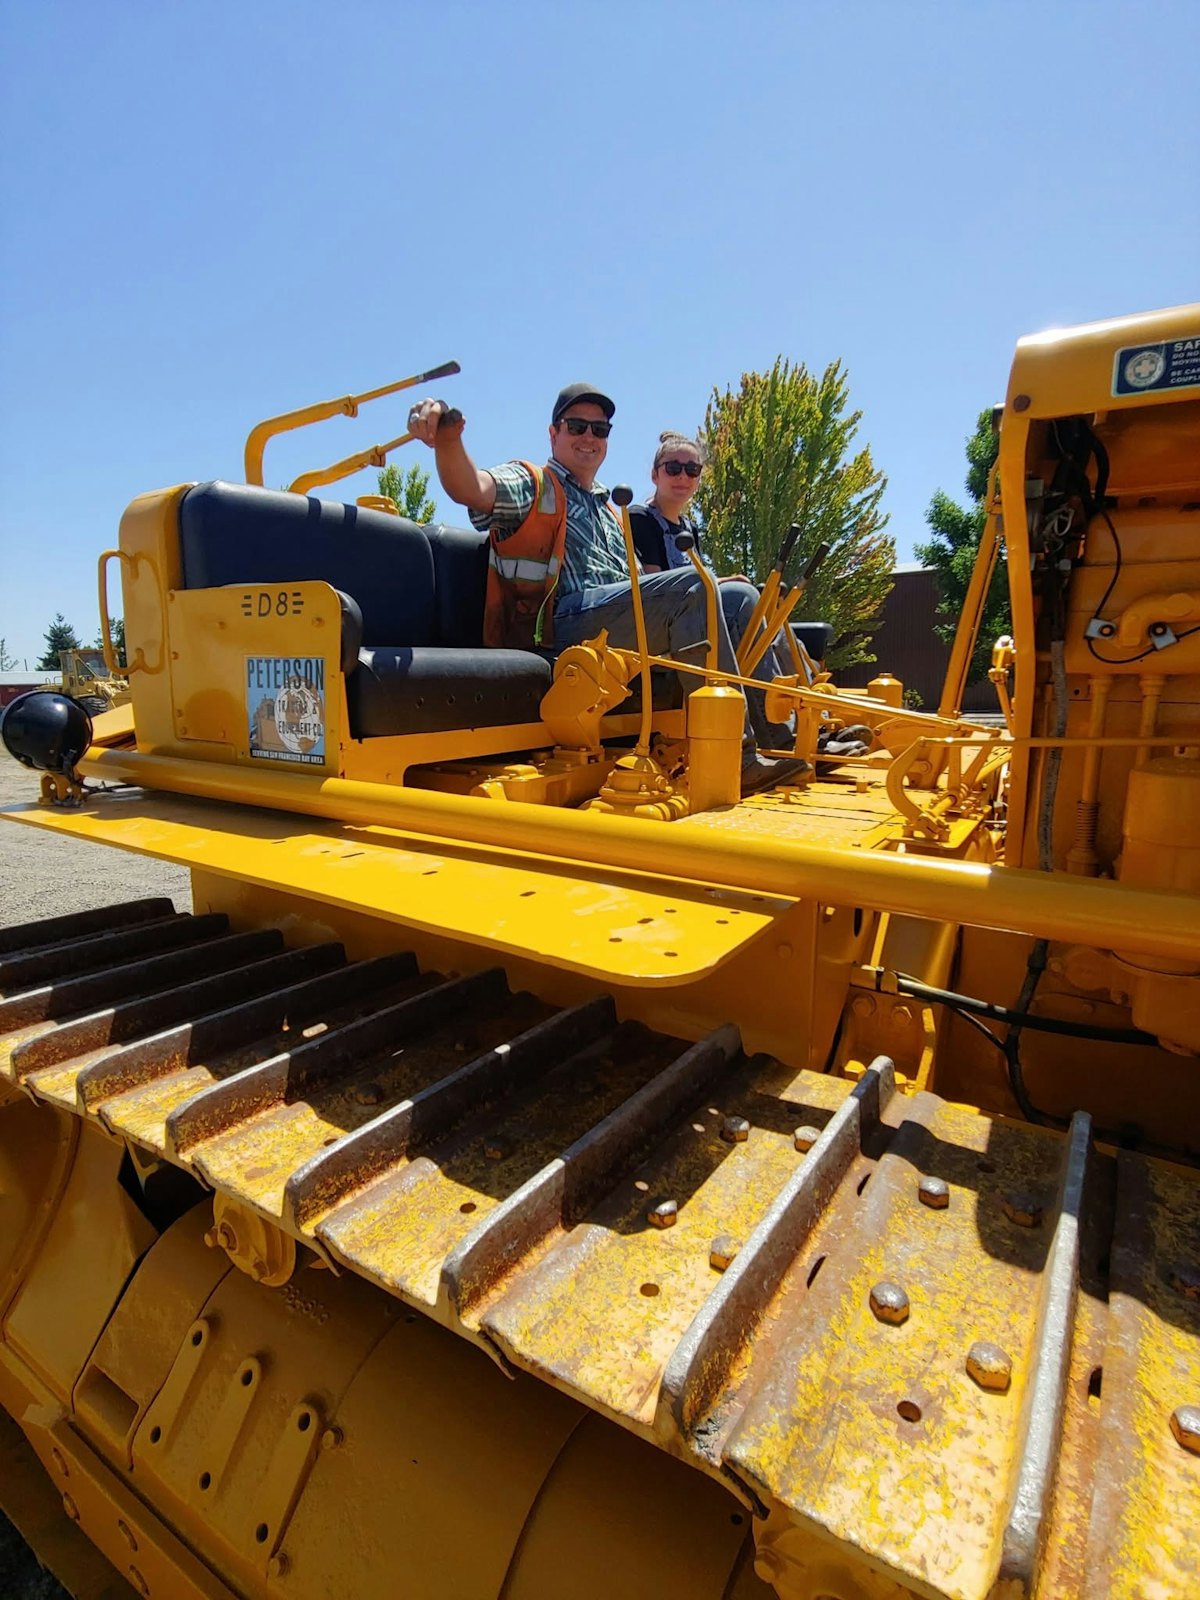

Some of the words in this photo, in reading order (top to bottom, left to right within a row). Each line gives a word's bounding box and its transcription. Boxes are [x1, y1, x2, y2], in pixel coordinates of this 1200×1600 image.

[1170, 375, 1200, 383] COUPL
[258, 592, 288, 617] D8
[247, 658, 324, 690] PETERSON
